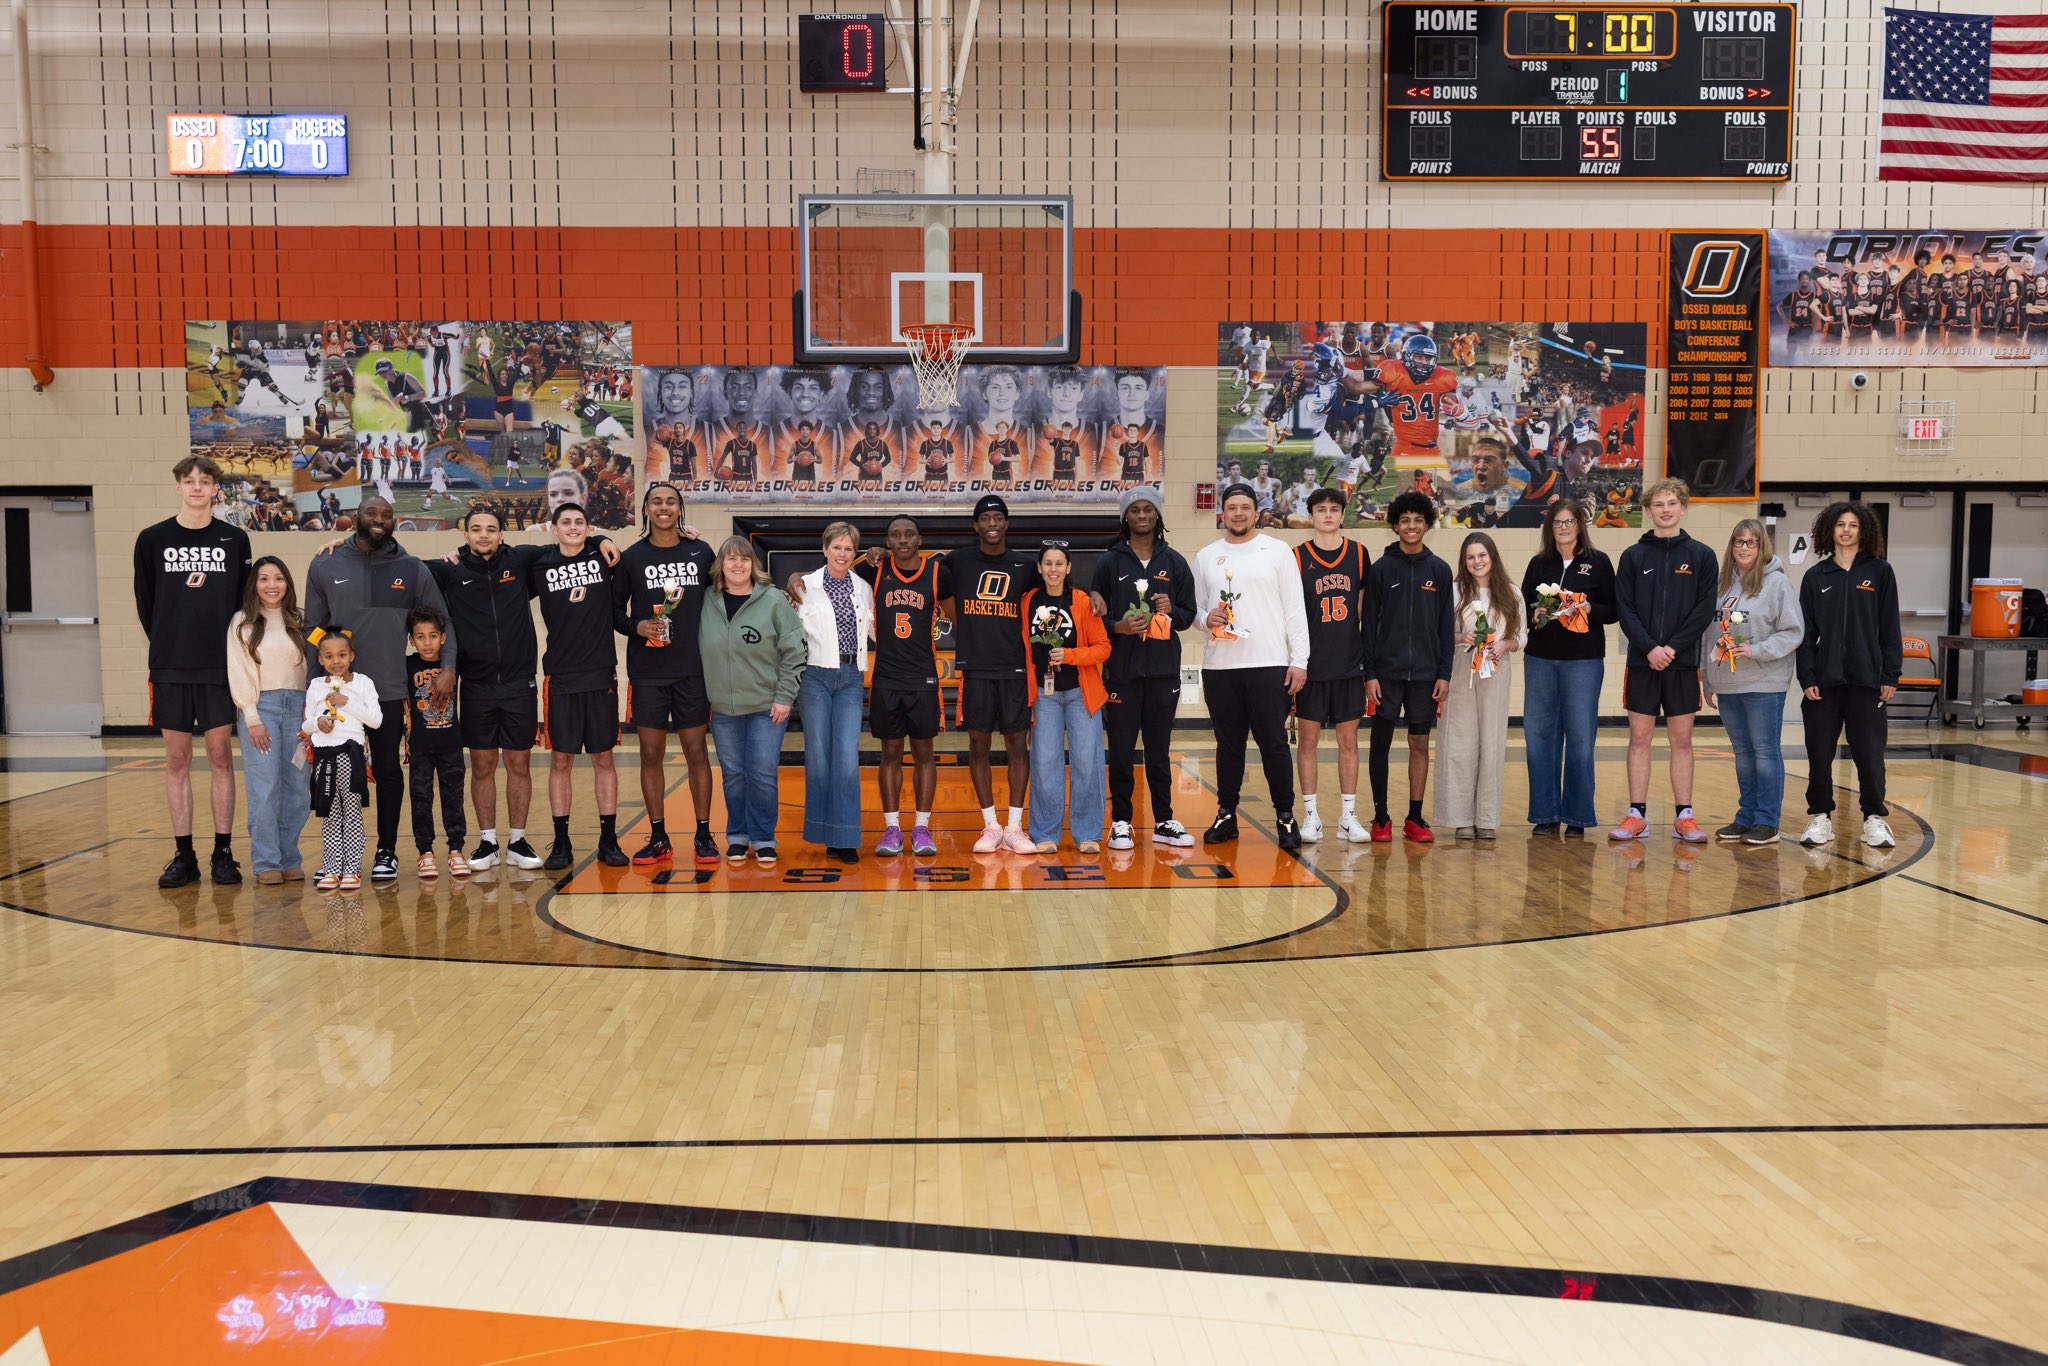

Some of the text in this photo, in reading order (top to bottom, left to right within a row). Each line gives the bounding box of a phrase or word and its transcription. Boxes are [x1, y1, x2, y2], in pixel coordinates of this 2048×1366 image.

[1415, 10, 1478, 31] HOME
[1693, 10, 1777, 32] VISITOR
[843, 24, 873, 78] 0
[1521, 61, 1548, 72] POSS
[1631, 61, 1658, 72] POSS
[1551, 77, 1599, 91] PERIOD
[1618, 71, 1626, 101] 1
[1433, 86, 1478, 99] BONUS
[1700, 87, 1744, 100] BONUS
[1410, 112, 1451, 125] FOULS
[1512, 112, 1560, 125] PLAYER
[1577, 112, 1624, 125] POINTS
[1635, 112, 1676, 125] FOULS
[1725, 112, 1766, 125] FOULS
[174, 118, 217, 137] OSSEO
[245, 119, 270, 136] 1ST
[292, 118, 346, 137] ROGERS
[1582, 128, 1619, 159] 55
[186, 138, 203, 169] 0
[231, 138, 284, 169] 7:00
[312, 139, 328, 169] 0
[1410, 162, 1452, 174] POINTS
[1579, 162, 1621, 175] MATCH
[1746, 163, 1788, 175] POINTS
[1825, 234, 2046, 265] ORIOLES
[1682, 303, 1747, 315] OSSEO ORIOLES
[1674, 319, 1753, 330] BOYS BASKETBALL
[1687, 335, 1740, 346] CONFERENCE
[1678, 351, 1747, 362] CHAMPIONSHIPS
[1670, 372, 1753, 382] 1975 1986 1994 1997
[1669, 386, 1753, 395] 2000 2001 2002 2003
[1400, 392, 1435, 423] 34
[1669, 398, 1753, 408] 2004 2007 2008 2009
[1670, 411, 1686, 420] 2011
[1689, 411, 1708, 421] 2012
[1914, 419, 1938, 438] EXIT
[1061, 452, 1071, 462] 14
[773, 480, 835, 494] ORIOLES
[840, 480, 902, 494] ORIOLES
[905, 480, 967, 494] ORIOLES
[970, 480, 1031, 493] ORIOLES
[1034, 480, 1095, 493] ORIOLES
[1792, 536, 1807, 553] A
[163, 547, 226, 562] OSSEO
[164, 562, 227, 572] BASKETBALL
[545, 559, 600, 583] OSSEO
[644, 562, 698, 579] OSSEO
[186, 572, 207, 588] O
[547, 573, 603, 592] BASKETBALL
[646, 575, 700, 590] BASTBALL
[976, 570, 1010, 600] O
[1315, 573, 1351, 595] OSSEO
[569, 586, 587, 603] O
[885, 588, 925, 610] OSSEO
[964, 600, 1018, 618] BASKETBALL
[1320, 595, 1348, 623] 15
[2007, 595, 2019, 610] G
[894, 612, 912, 639] 5
[1904, 641, 1925, 650] SEO
[414, 667, 442, 688] OSS
